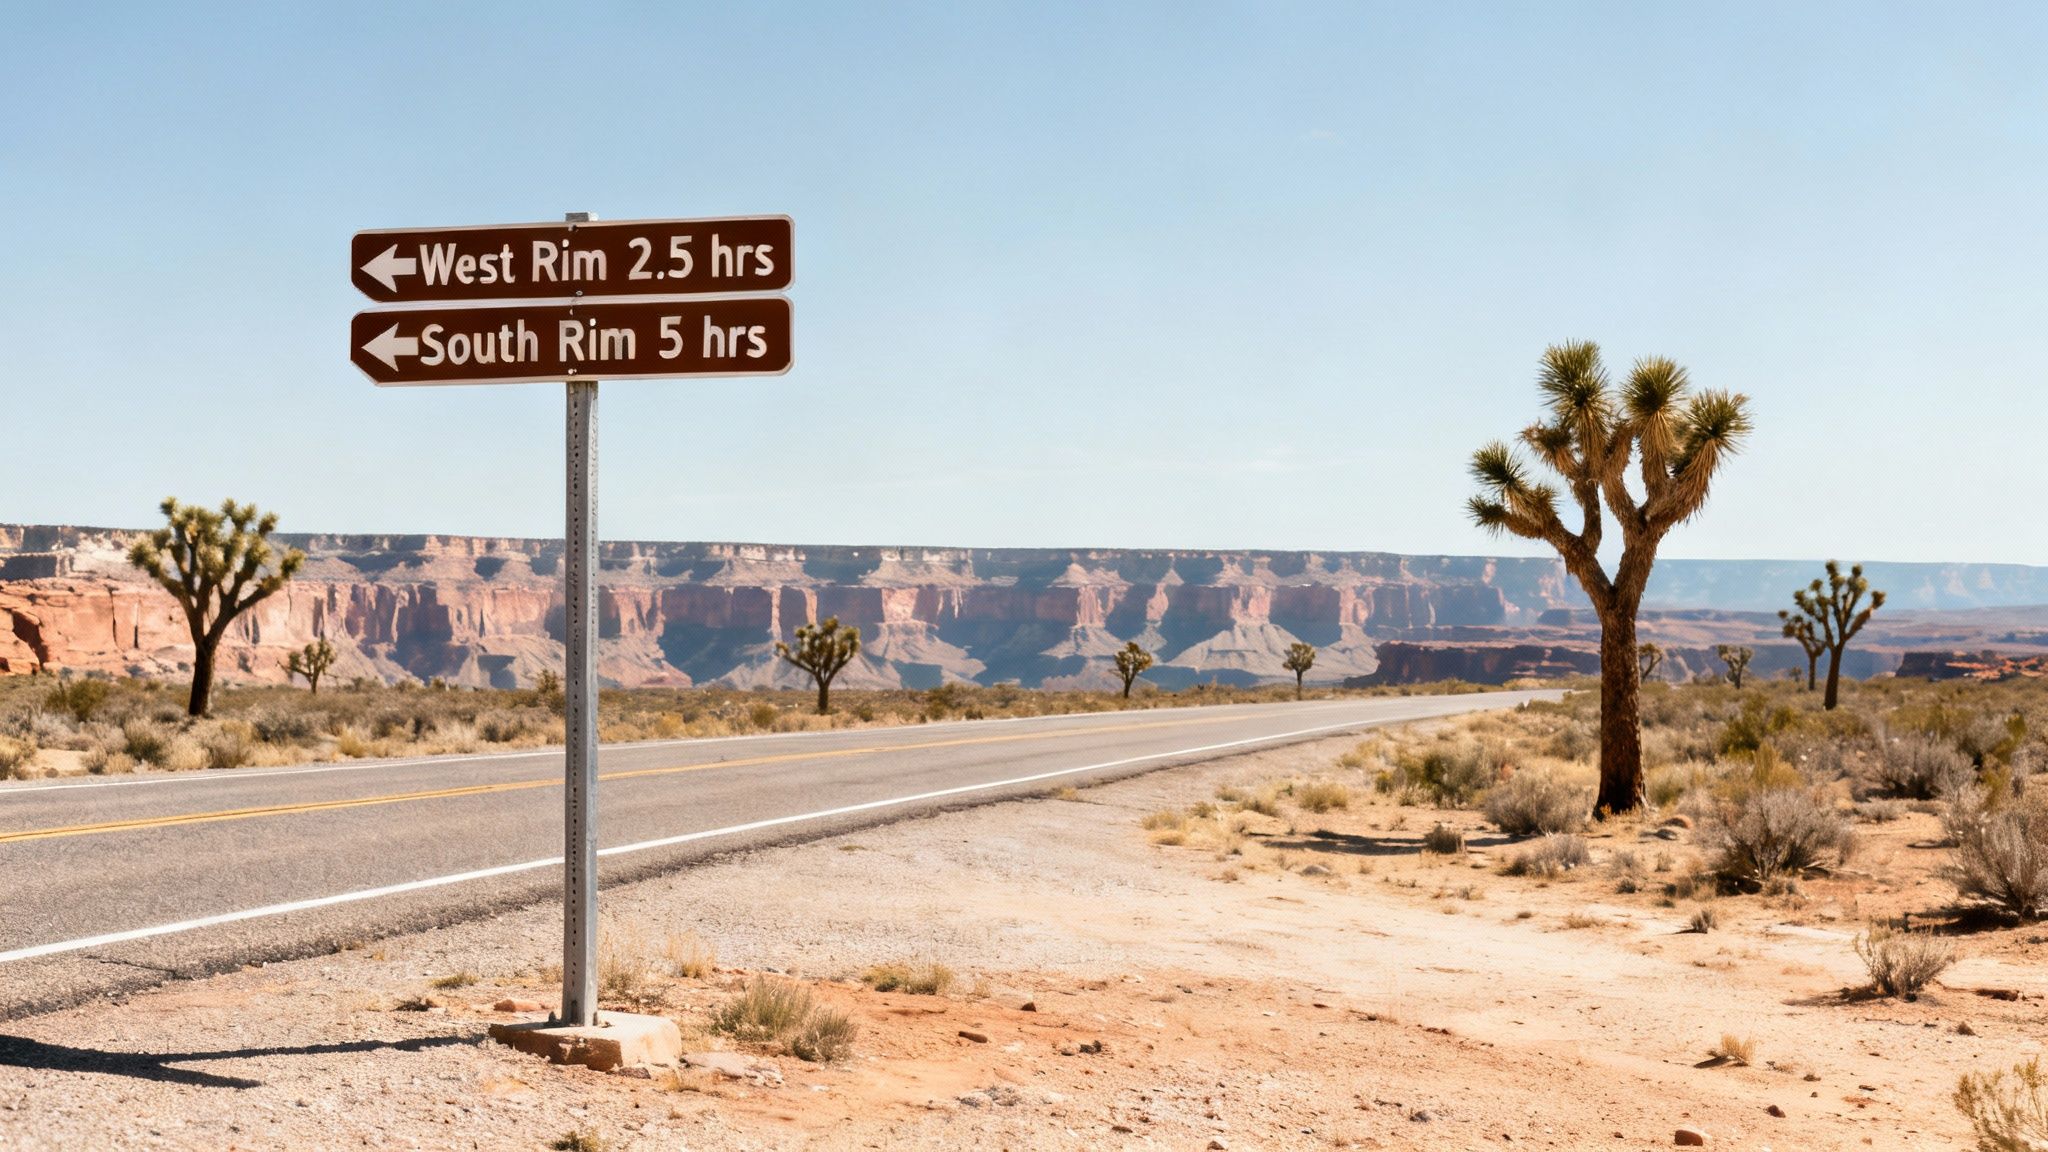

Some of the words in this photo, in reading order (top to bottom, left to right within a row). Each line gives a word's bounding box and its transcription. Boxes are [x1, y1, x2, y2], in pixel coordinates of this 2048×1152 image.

[419, 243, 516, 286] West
[532, 239, 607, 282] Rim
[628, 235, 693, 280] 2.5
[711, 234, 774, 277] hrs
[420, 319, 538, 366] South
[559, 318, 636, 362] Rim
[659, 316, 683, 359] 5
[703, 315, 767, 358] hrs
